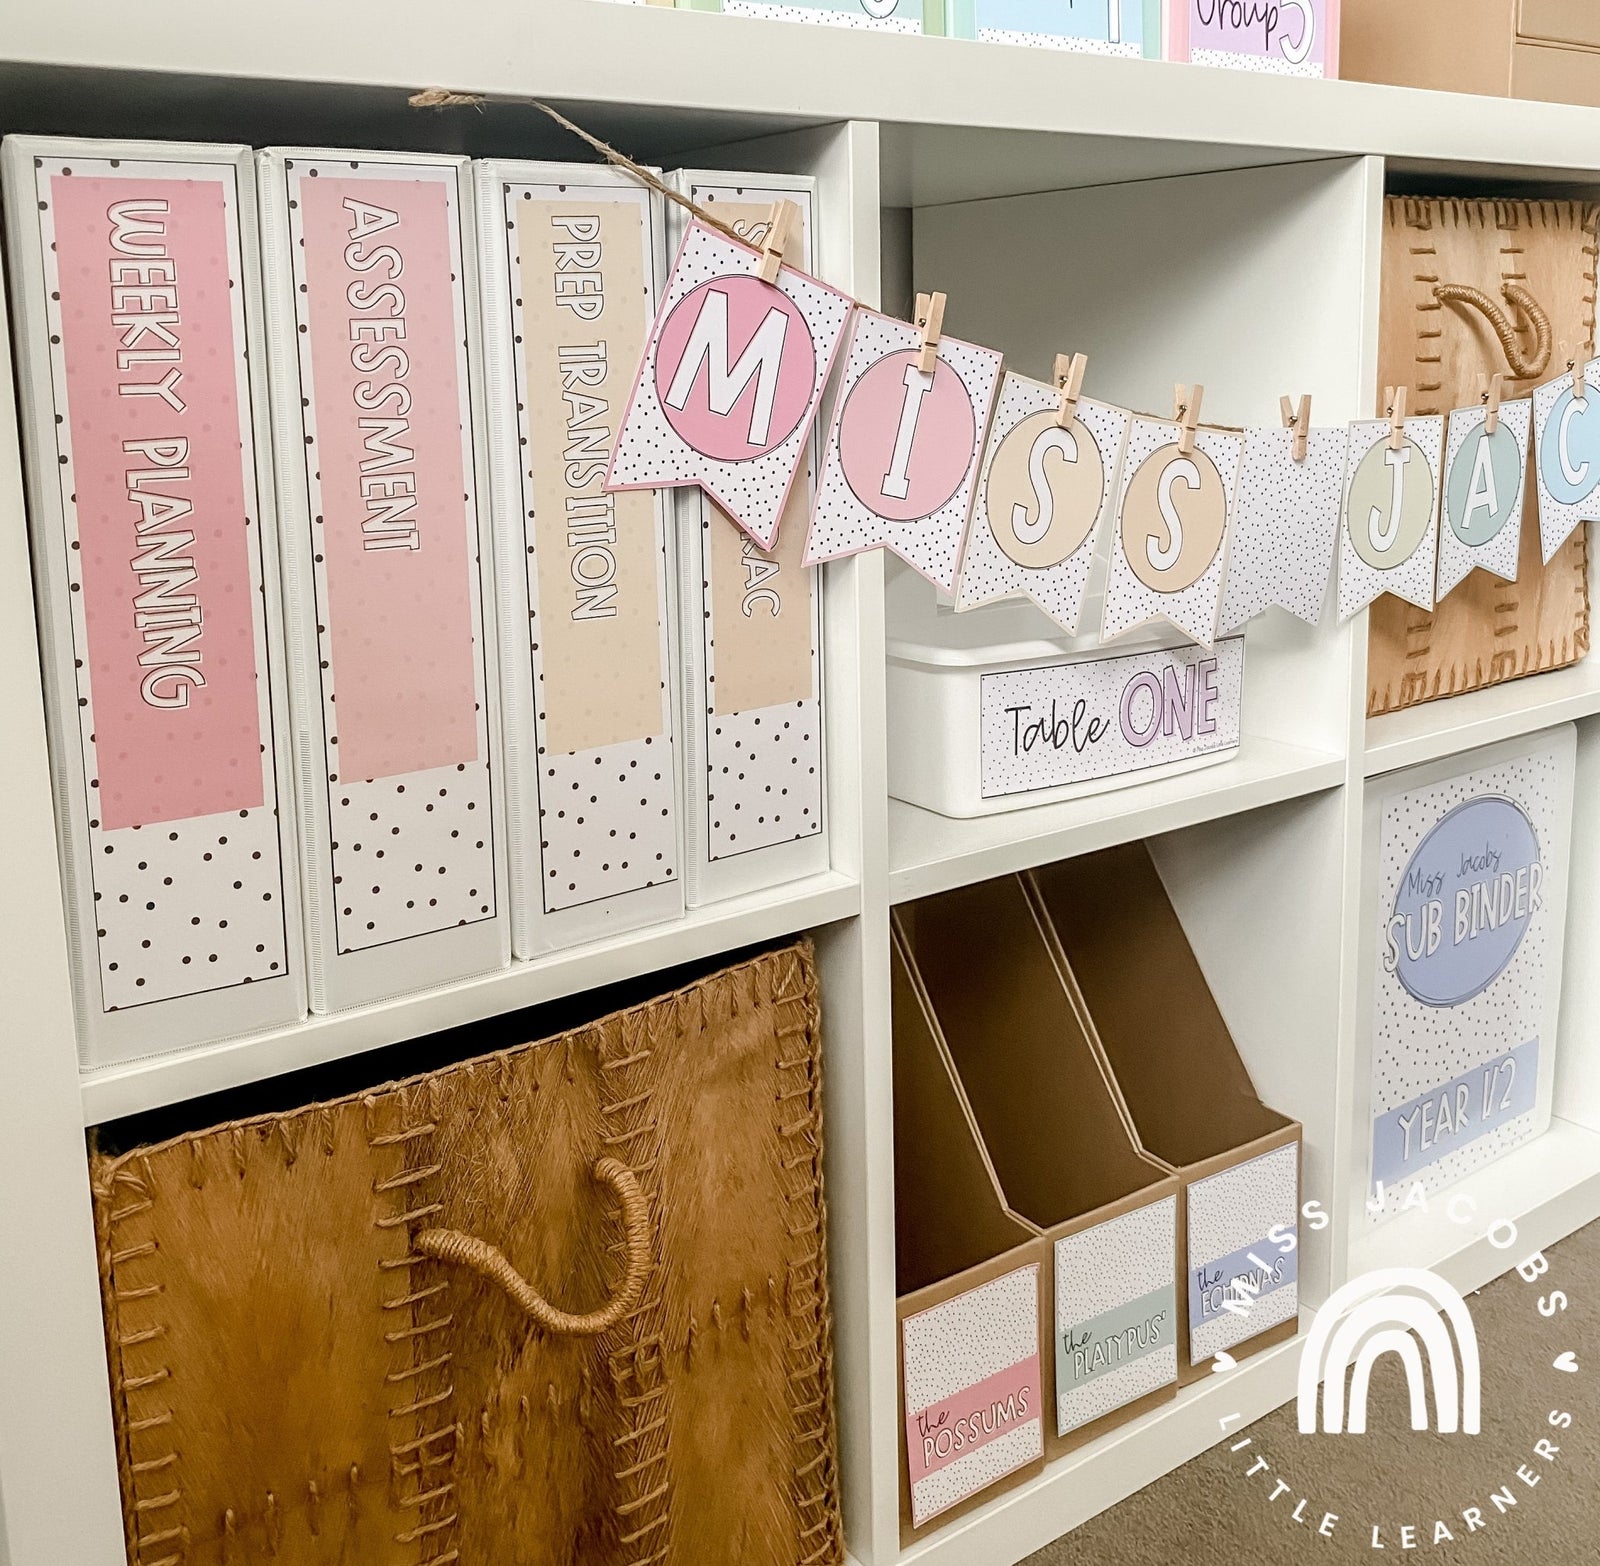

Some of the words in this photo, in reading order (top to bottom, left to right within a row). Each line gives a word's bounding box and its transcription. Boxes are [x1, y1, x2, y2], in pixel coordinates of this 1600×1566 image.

[106, 198, 187, 415] WEEKLY
[550, 215, 605, 321] PREP
[341, 197, 421, 552] ASSESSMENT
[558, 340, 618, 620] TRANSITION
[664, 288, 1201, 571] MISS
[122, 437, 207, 709] PLANNING
[1004, 699, 1110, 756] Table
[1119, 657, 1218, 747] ONE
[1383, 900, 1443, 973] SUB
[1454, 861, 1543, 946] BINDER
[1408, 867, 1446, 898] Miss
[1456, 840, 1503, 878] Jacobs
[1397, 1083, 1470, 1161] YEAR
[1197, 1268, 1224, 1291] the
[1063, 1329, 1092, 1355] the
[916, 1408, 950, 1437] the
[923, 1385, 1031, 1469] POSSUMS
